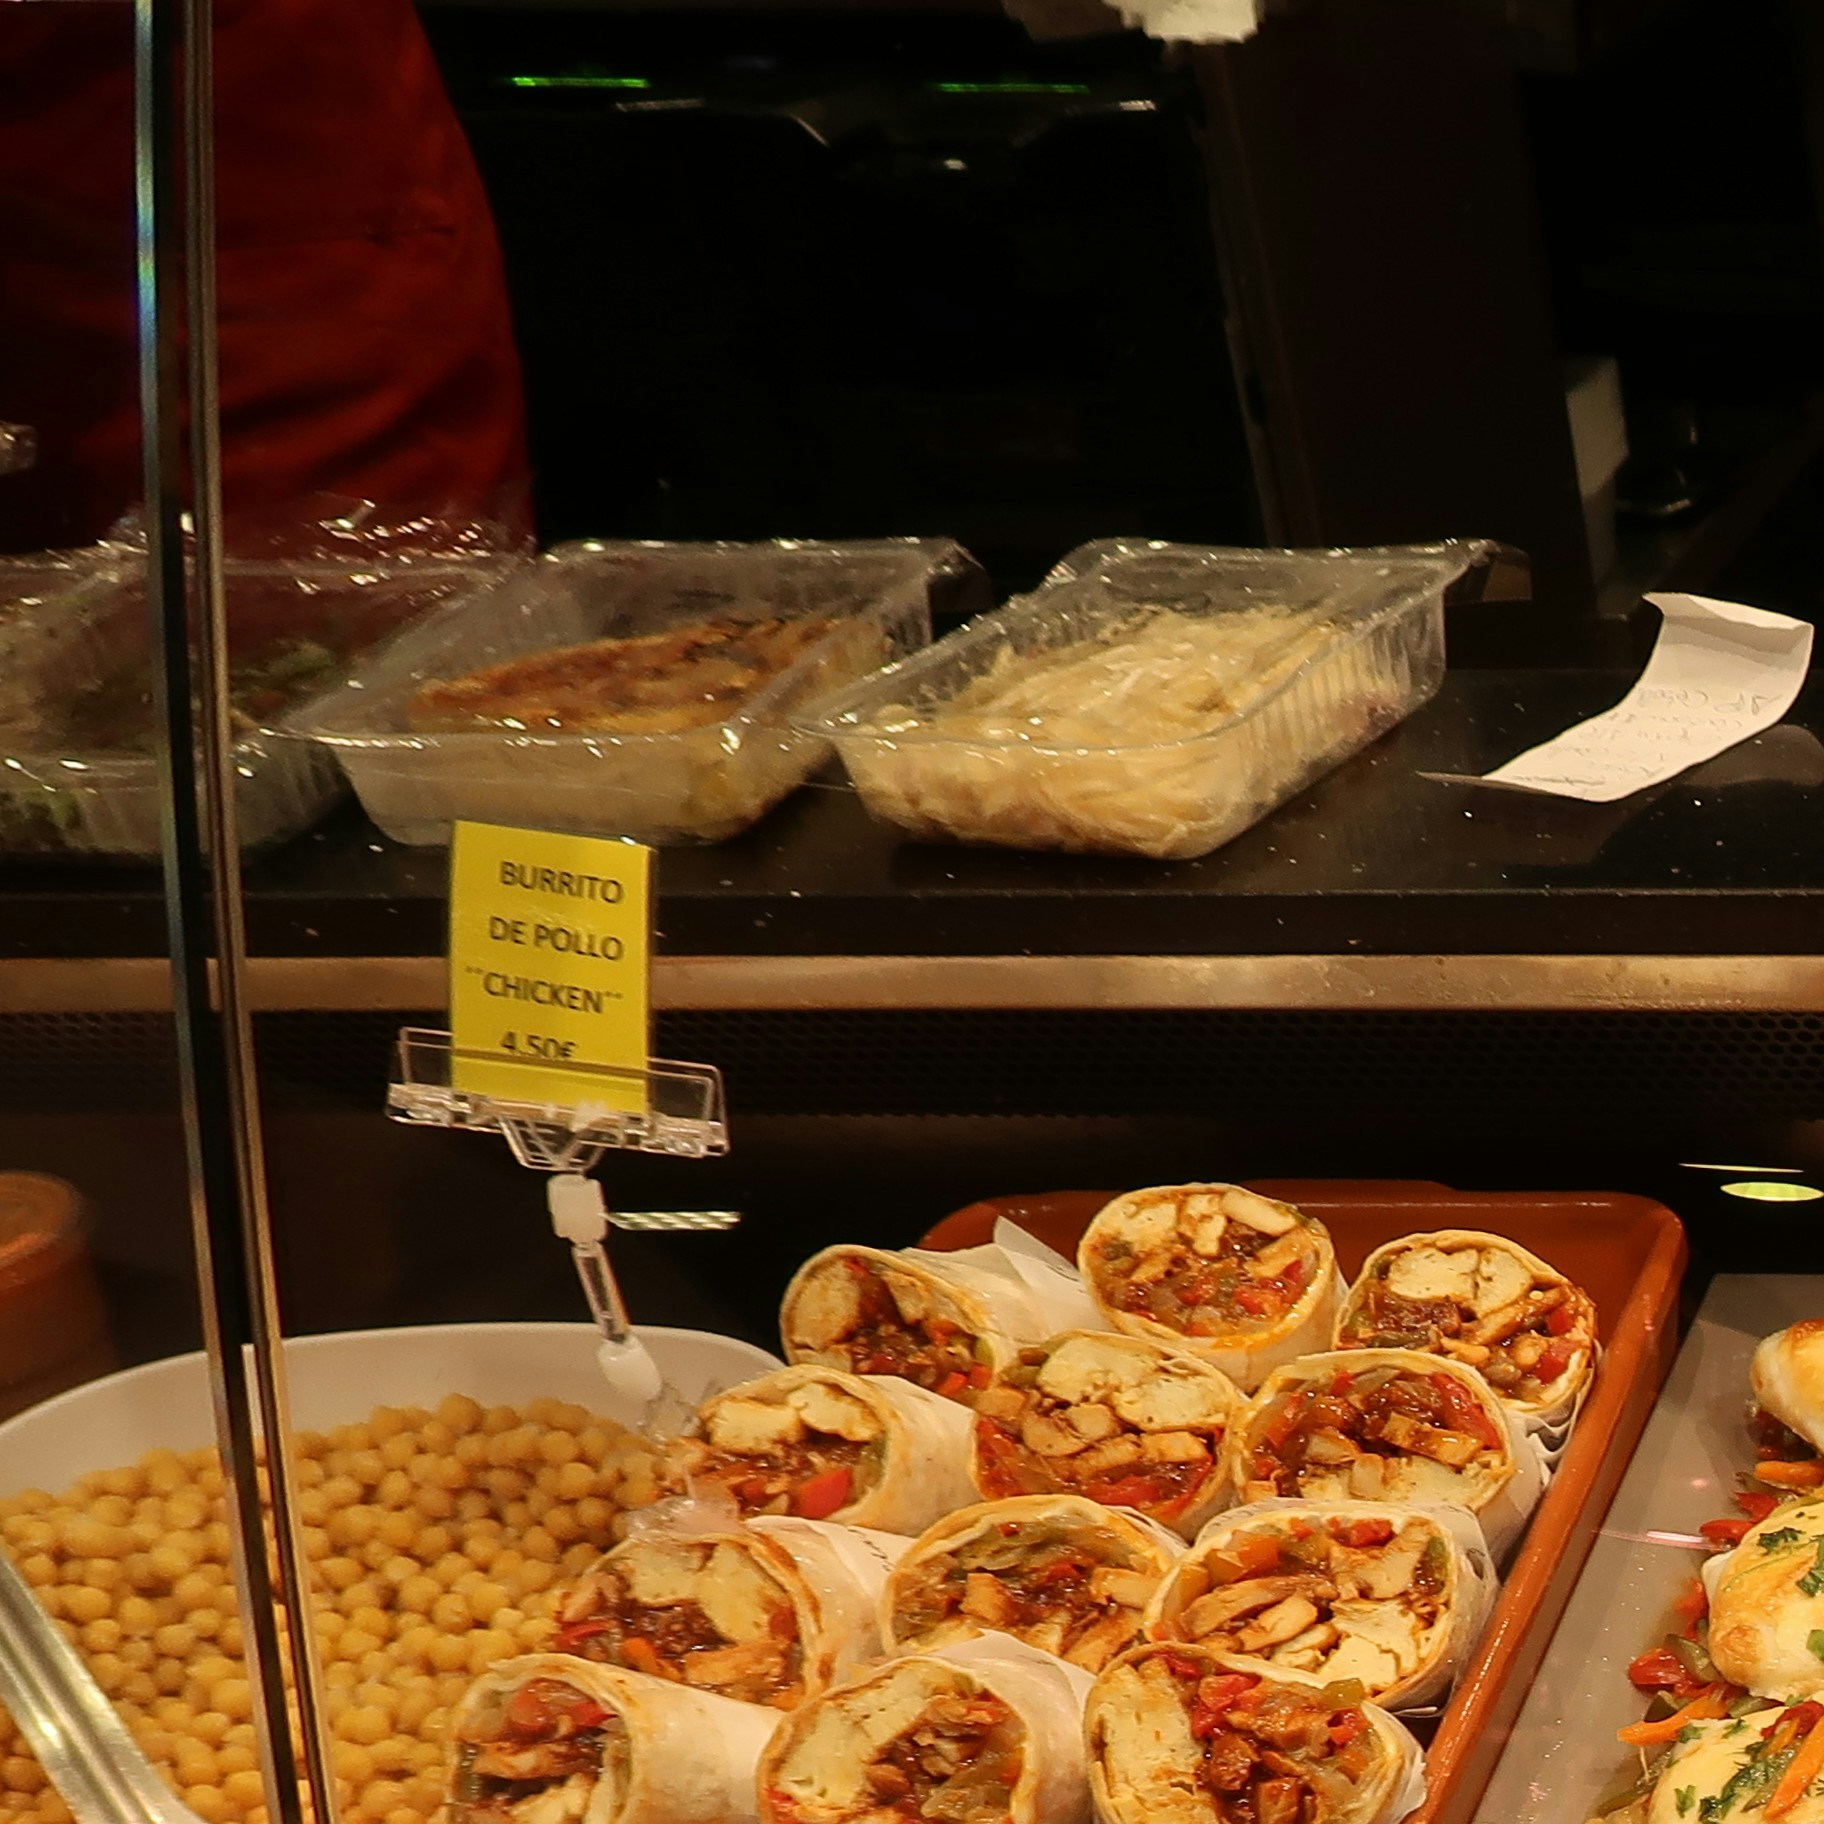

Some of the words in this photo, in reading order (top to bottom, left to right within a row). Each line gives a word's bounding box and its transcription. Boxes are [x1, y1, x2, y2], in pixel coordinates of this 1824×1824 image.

[499, 861, 624, 904] BURRITO
[489, 916, 526, 945] DE
[534, 924, 624, 961] POLLO
